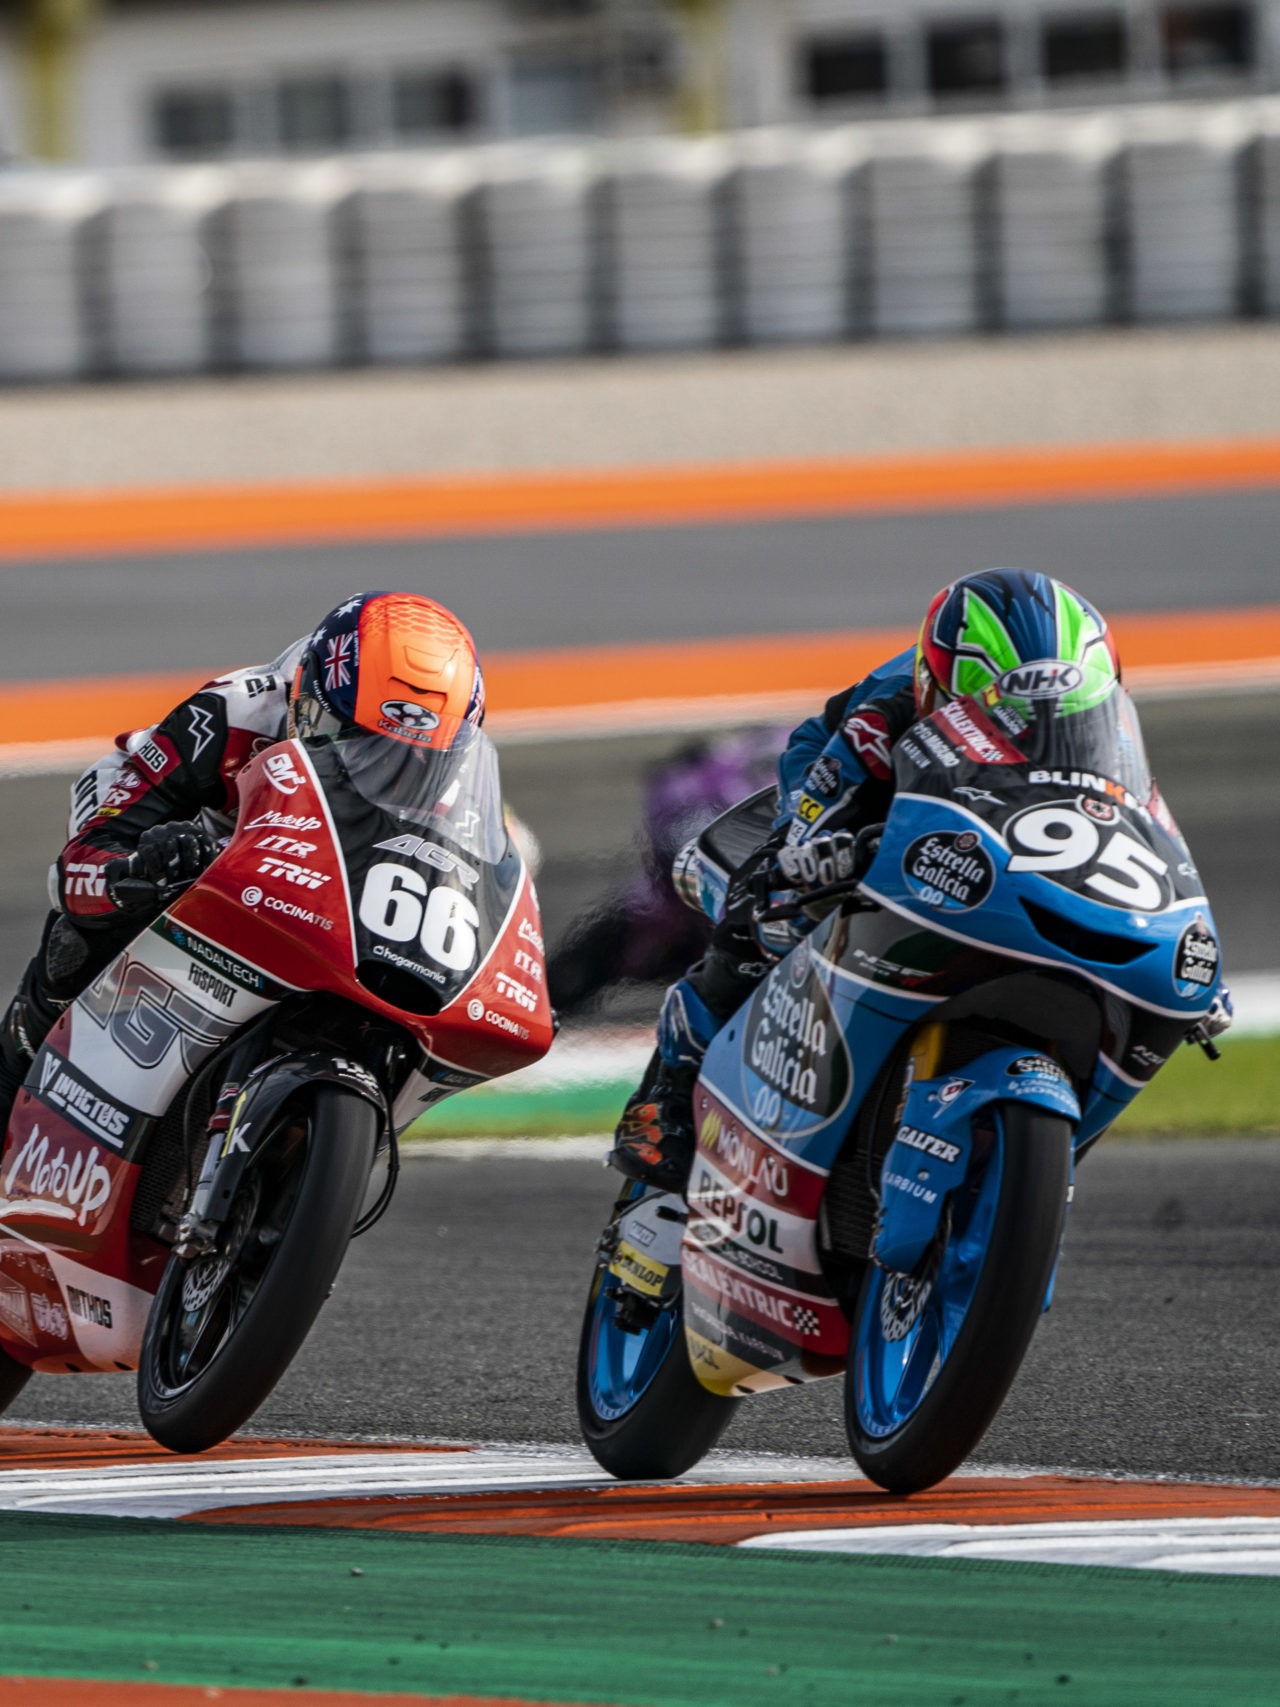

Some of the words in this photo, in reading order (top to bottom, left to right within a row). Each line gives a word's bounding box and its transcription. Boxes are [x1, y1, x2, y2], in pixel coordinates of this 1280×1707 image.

[1006, 667, 1074, 692] NHK
[940, 700, 997, 758] SCALEXTRIC
[244, 810, 322, 831] MotoUp
[257, 857, 333, 889] TRW
[373, 833, 480, 890] AGR
[911, 855, 970, 902] Galicia
[921, 837, 985, 884] Estrella
[1008, 807, 1168, 911] 95
[263, 896, 334, 931] COCINATIS
[359, 863, 480, 971] 66
[496, 971, 539, 1013] TRW
[761, 966, 827, 1057] Estrella
[751, 1018, 818, 1105] Galicia
[53, 1073, 131, 1137] INVICTUS
[896, 1125, 962, 1163] GALFER
[5, 1123, 111, 1227] MotoUp
